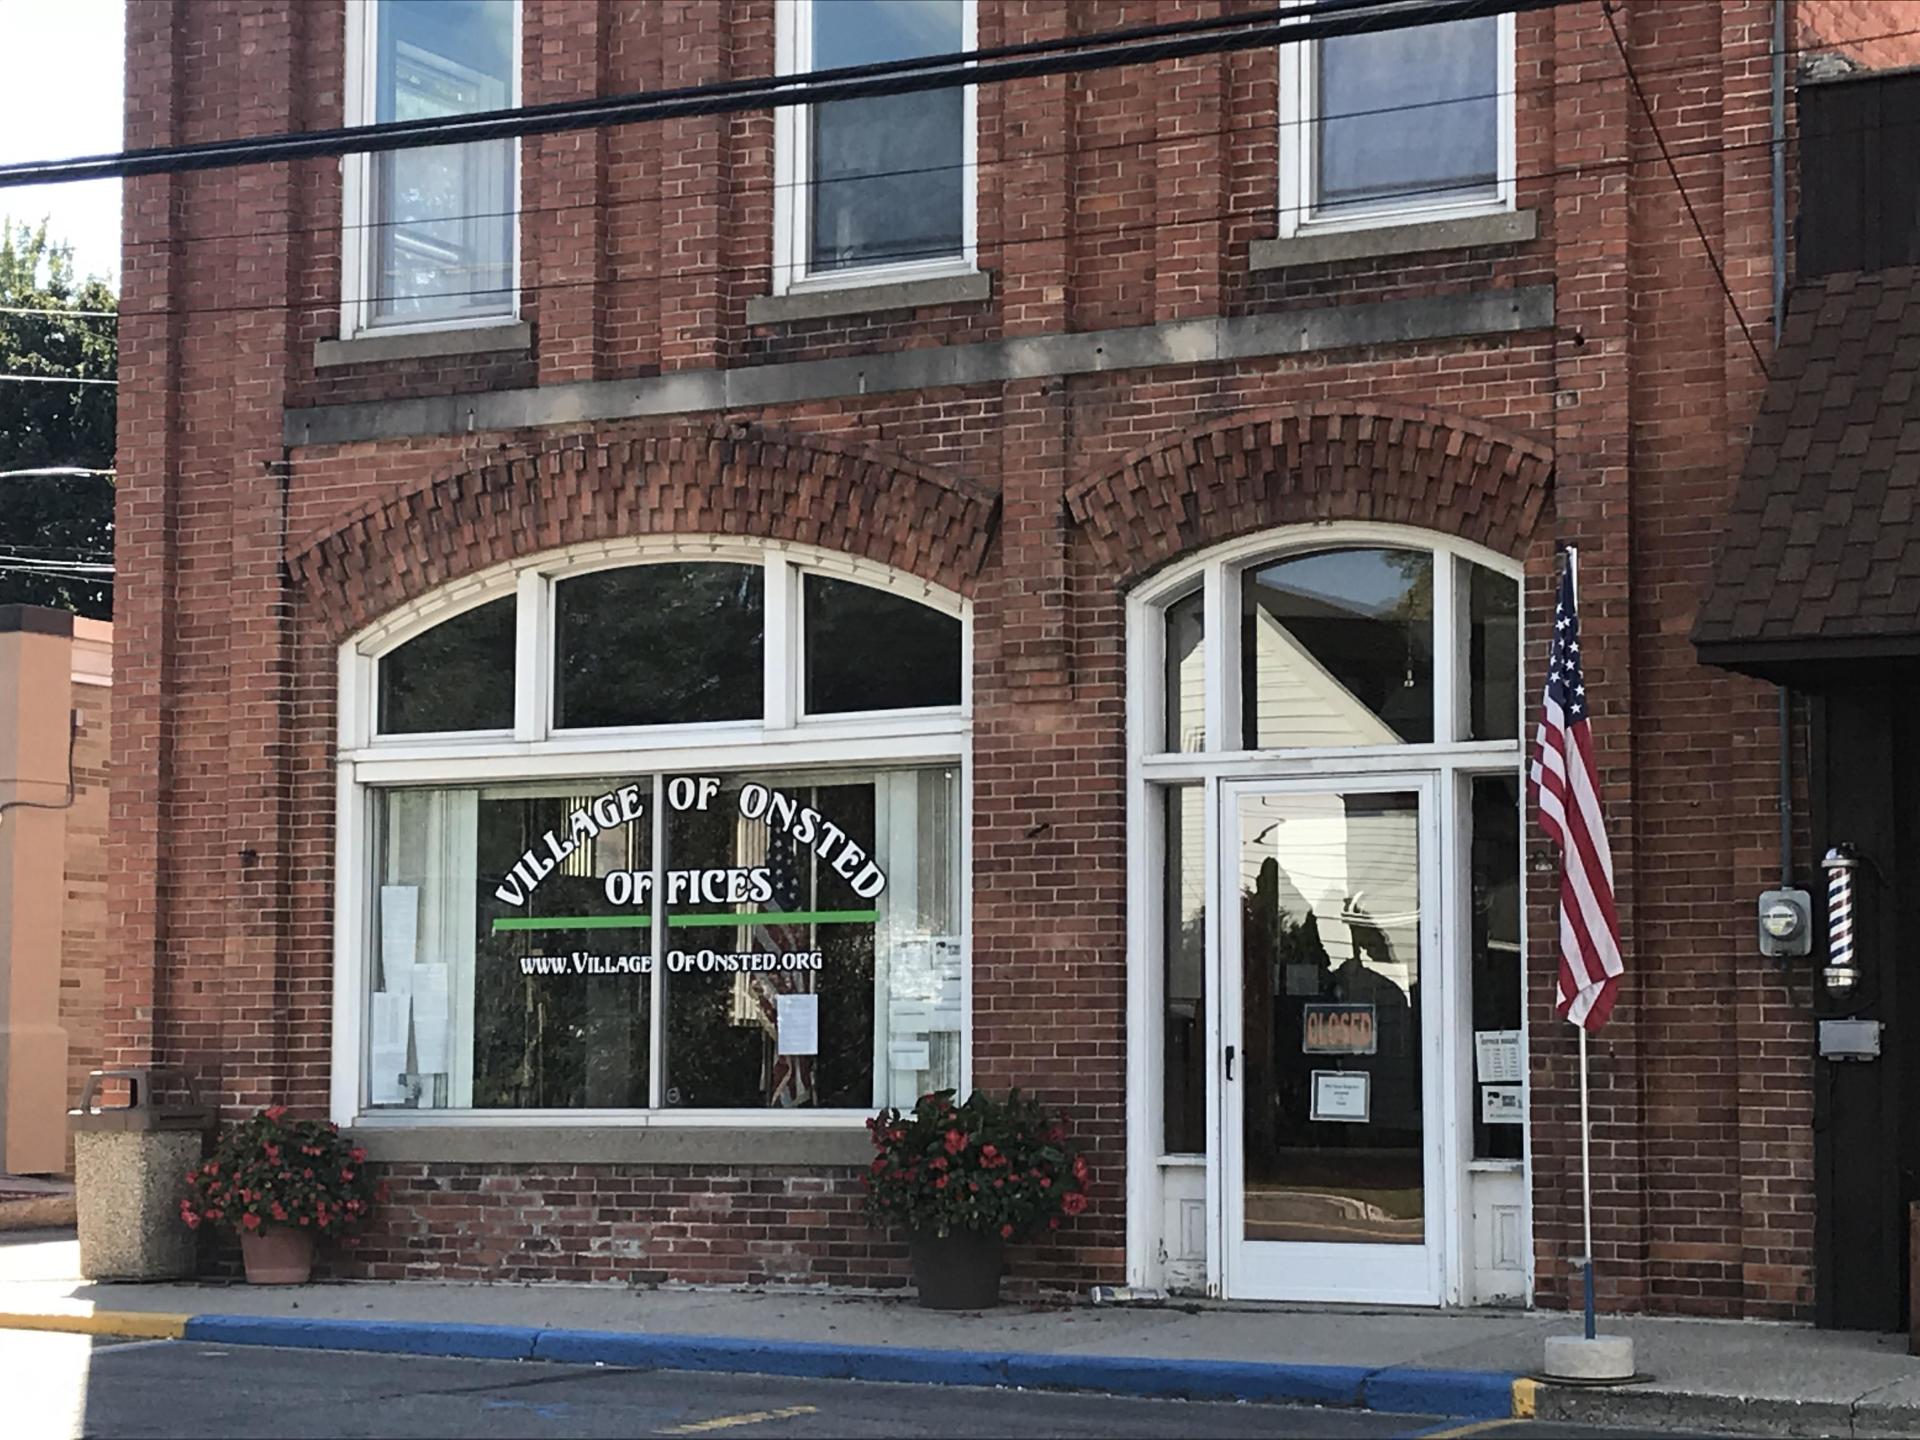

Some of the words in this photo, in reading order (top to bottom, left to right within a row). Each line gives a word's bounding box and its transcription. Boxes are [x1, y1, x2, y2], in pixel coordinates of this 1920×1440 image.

[495, 784, 643, 907] VILLAGE
[667, 777, 720, 811] OF
[739, 783, 887, 899] ONSTED
[1307, 1012, 1373, 1046] CLOSED
